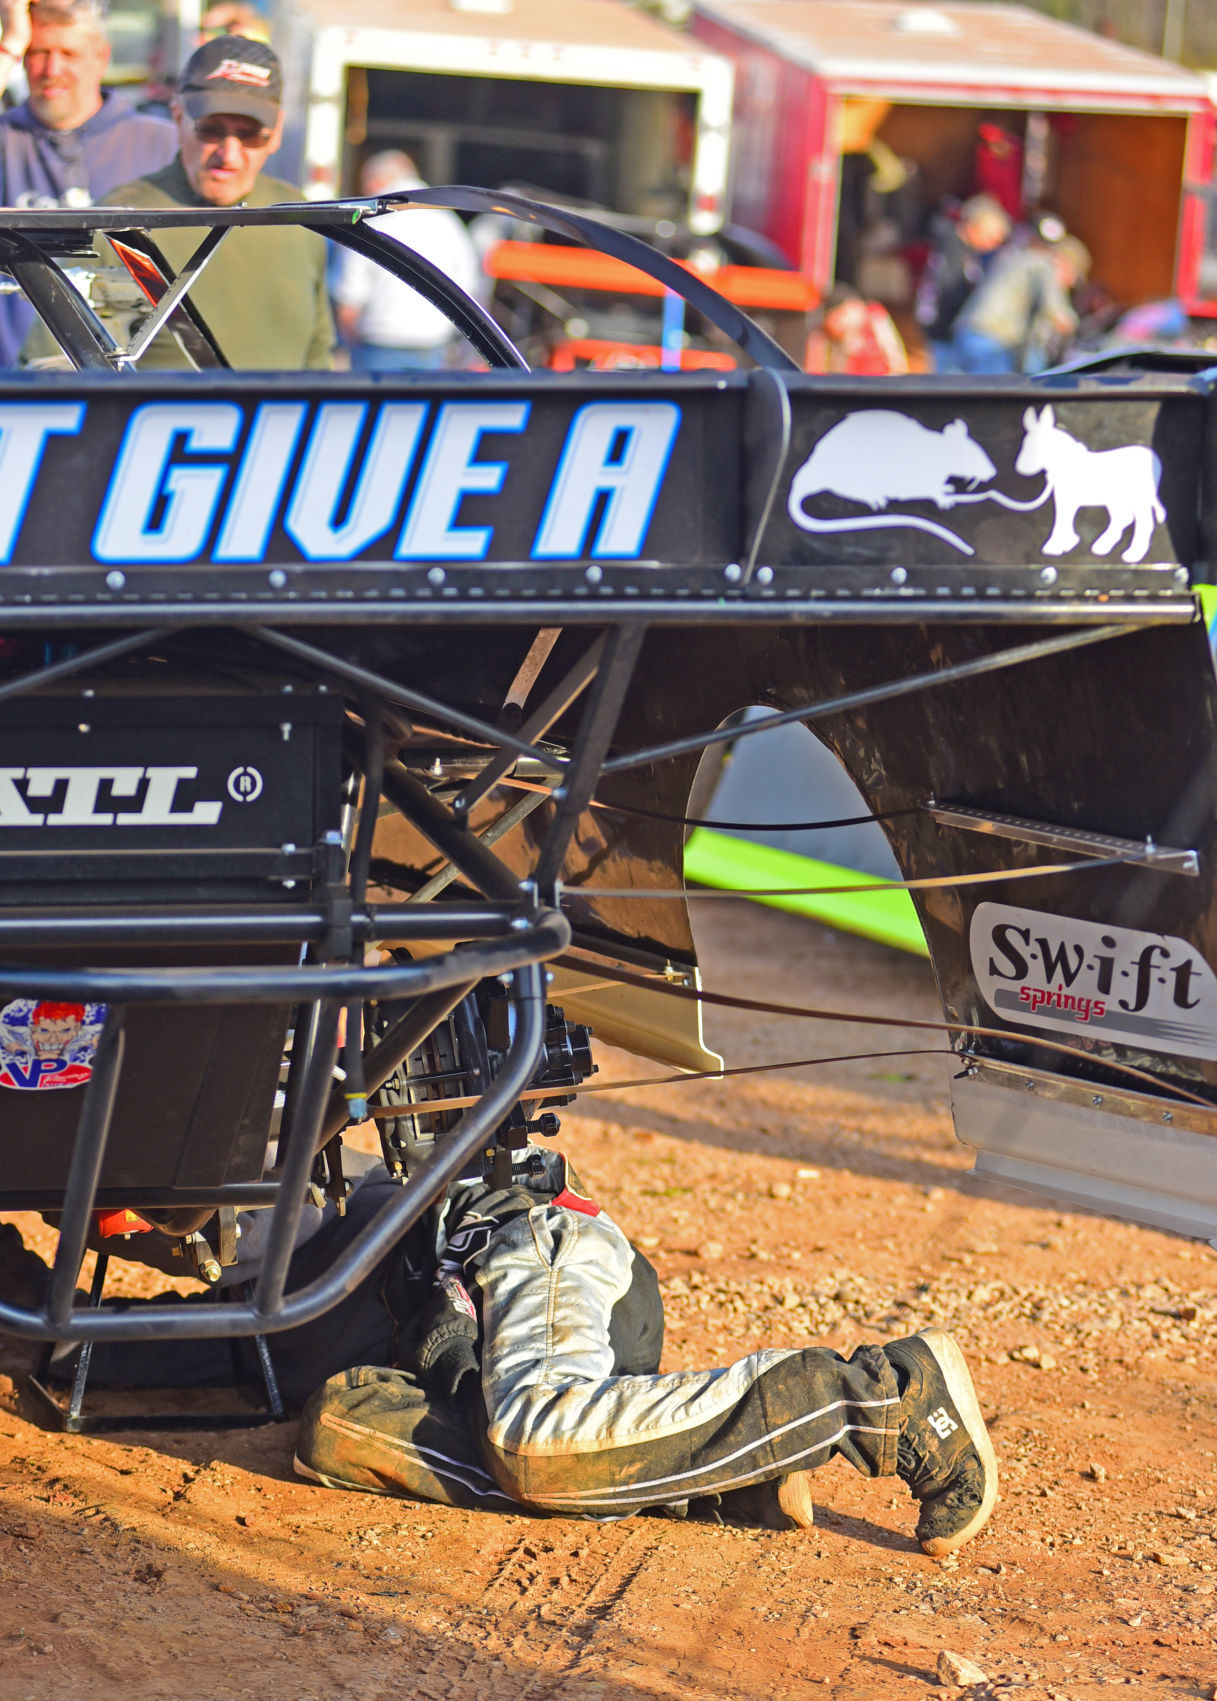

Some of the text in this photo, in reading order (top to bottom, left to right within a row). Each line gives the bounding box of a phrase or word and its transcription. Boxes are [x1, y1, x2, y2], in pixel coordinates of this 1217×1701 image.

[91, 400, 532, 564] GIVE
[530, 399, 682, 560] A
[1019, 983, 1106, 1021] springs
[5, 1058, 68, 1088] VP
